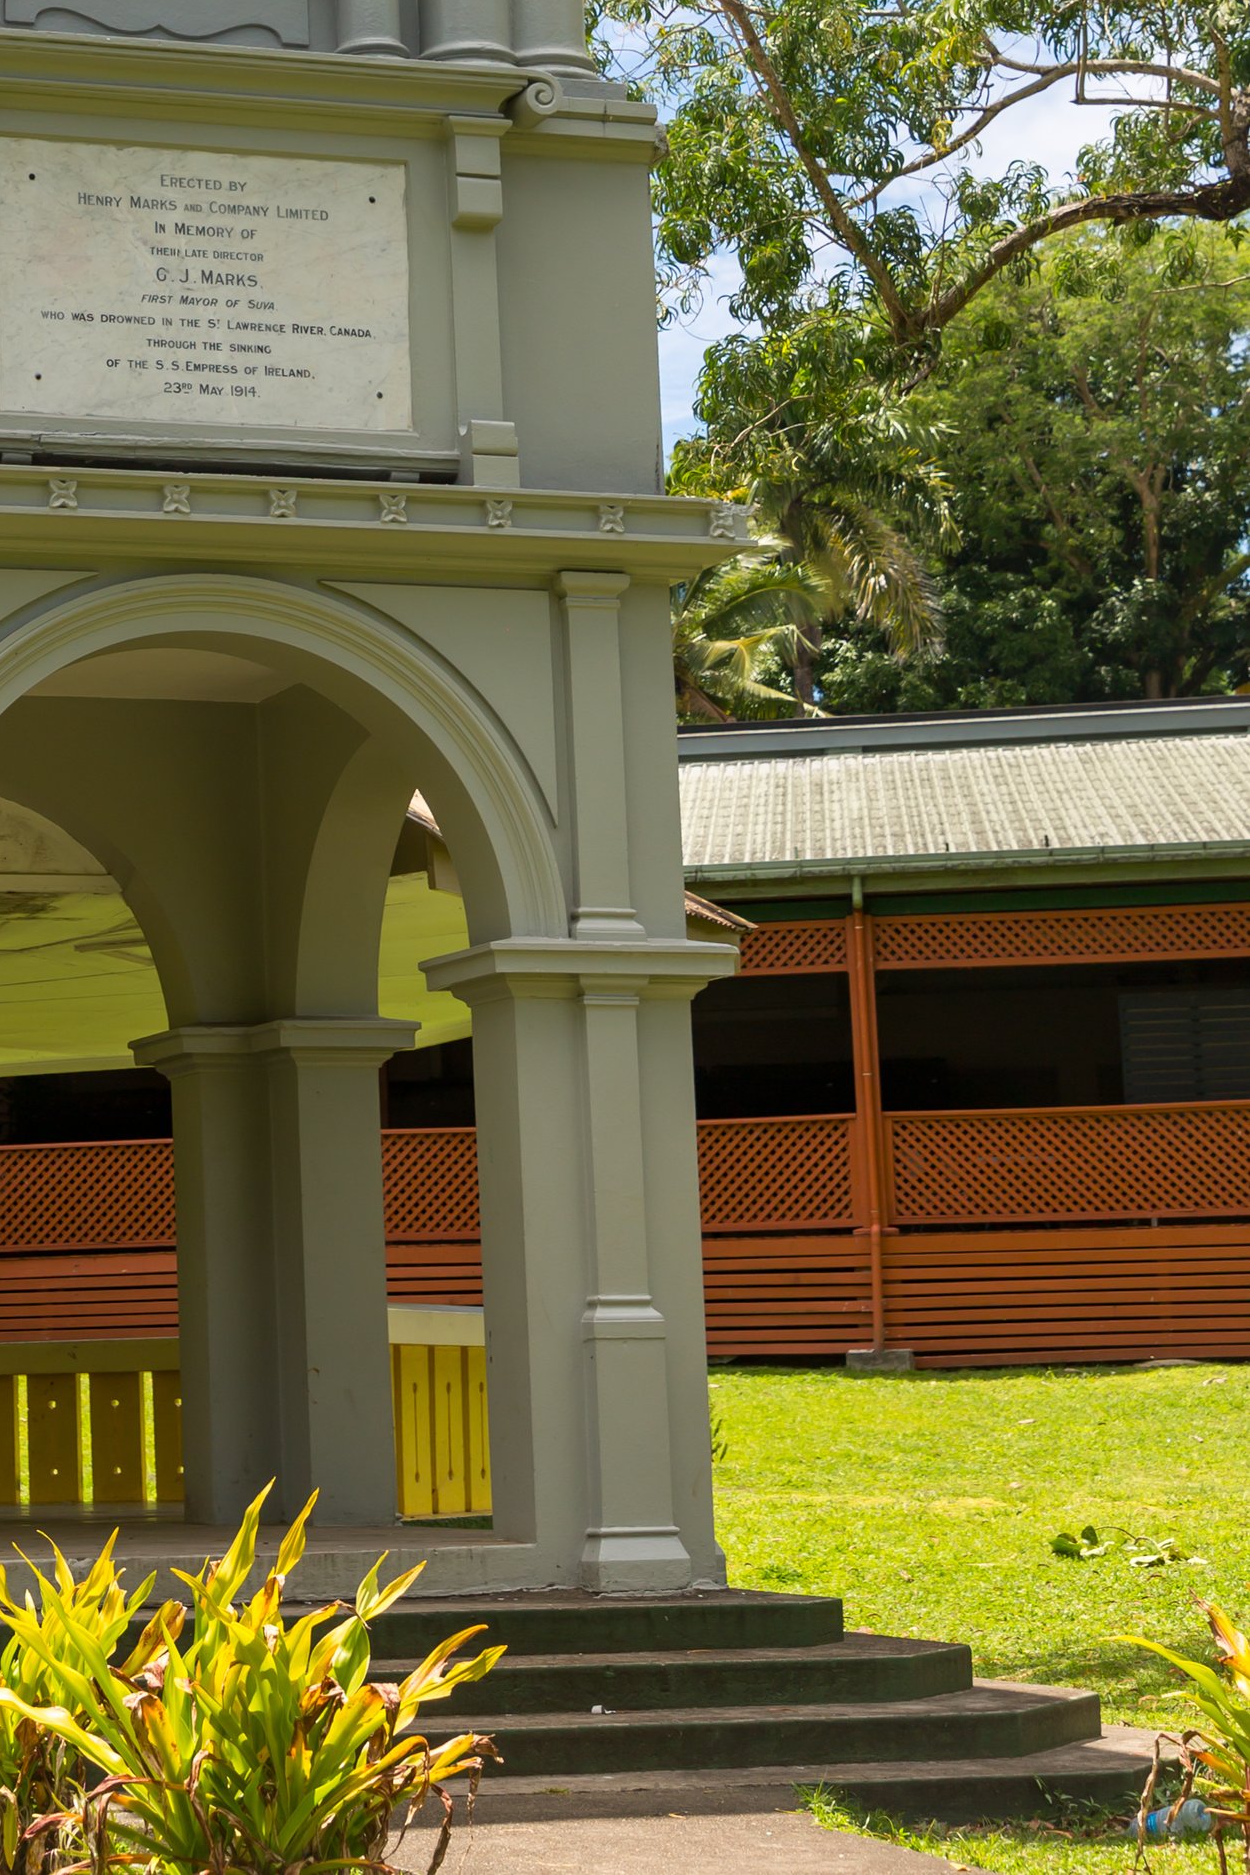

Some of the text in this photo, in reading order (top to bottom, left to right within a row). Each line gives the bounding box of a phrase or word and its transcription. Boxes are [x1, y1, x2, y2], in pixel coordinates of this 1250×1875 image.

[160, 174, 248, 192] ERECTED BY
[78, 192, 329, 221] HENRY MARKS AND COMPANY LIMITED
[155, 221, 257, 240] IN MEMORY OF
[185, 248, 209, 259] LATE
[213, 250, 264, 262] DIRECTOR
[141, 294, 173, 304] FIRST
[179, 295, 218, 307] MAYOR
[225, 299, 241, 308] OF
[41, 310, 65, 321] WHO
[71, 312, 94, 322] WAS
[100, 313, 156, 326] DROWNED
[162, 316, 173, 326] IN
[179, 318, 200, 328] THE
[227, 320, 286, 334] LAWRENCE
[147, 337, 272, 355] THROUGH THE SINKING
[106, 359, 121, 369] OF
[128, 360, 149, 370] THE
[244, 366, 259, 375] OF
[200, 384, 224, 396] MAY
